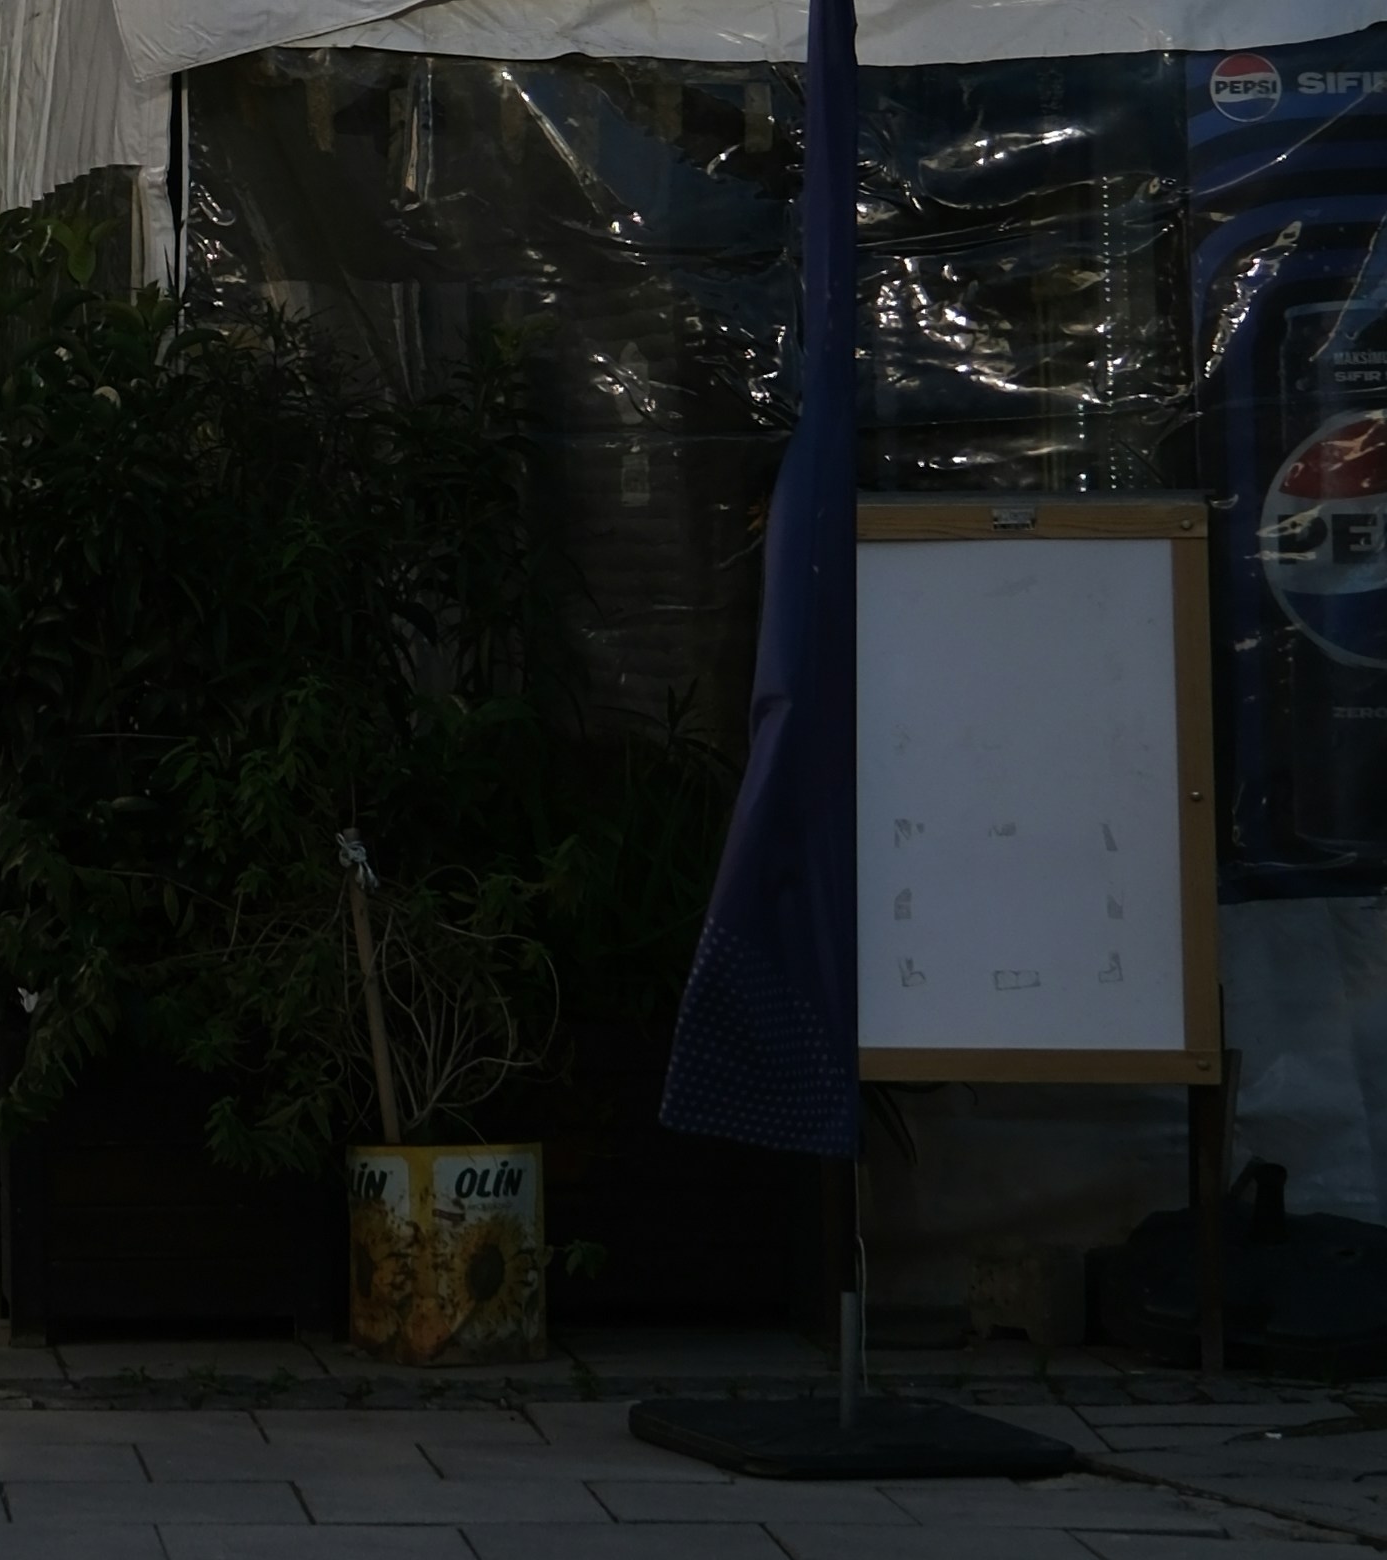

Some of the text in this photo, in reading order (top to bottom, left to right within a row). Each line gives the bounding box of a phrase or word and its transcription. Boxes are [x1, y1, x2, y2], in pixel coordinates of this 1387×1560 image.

[1215, 80, 1277, 95] PEPSI
[1278, 513, 1387, 566] PE
[455, 1160, 523, 1198] OLİN
